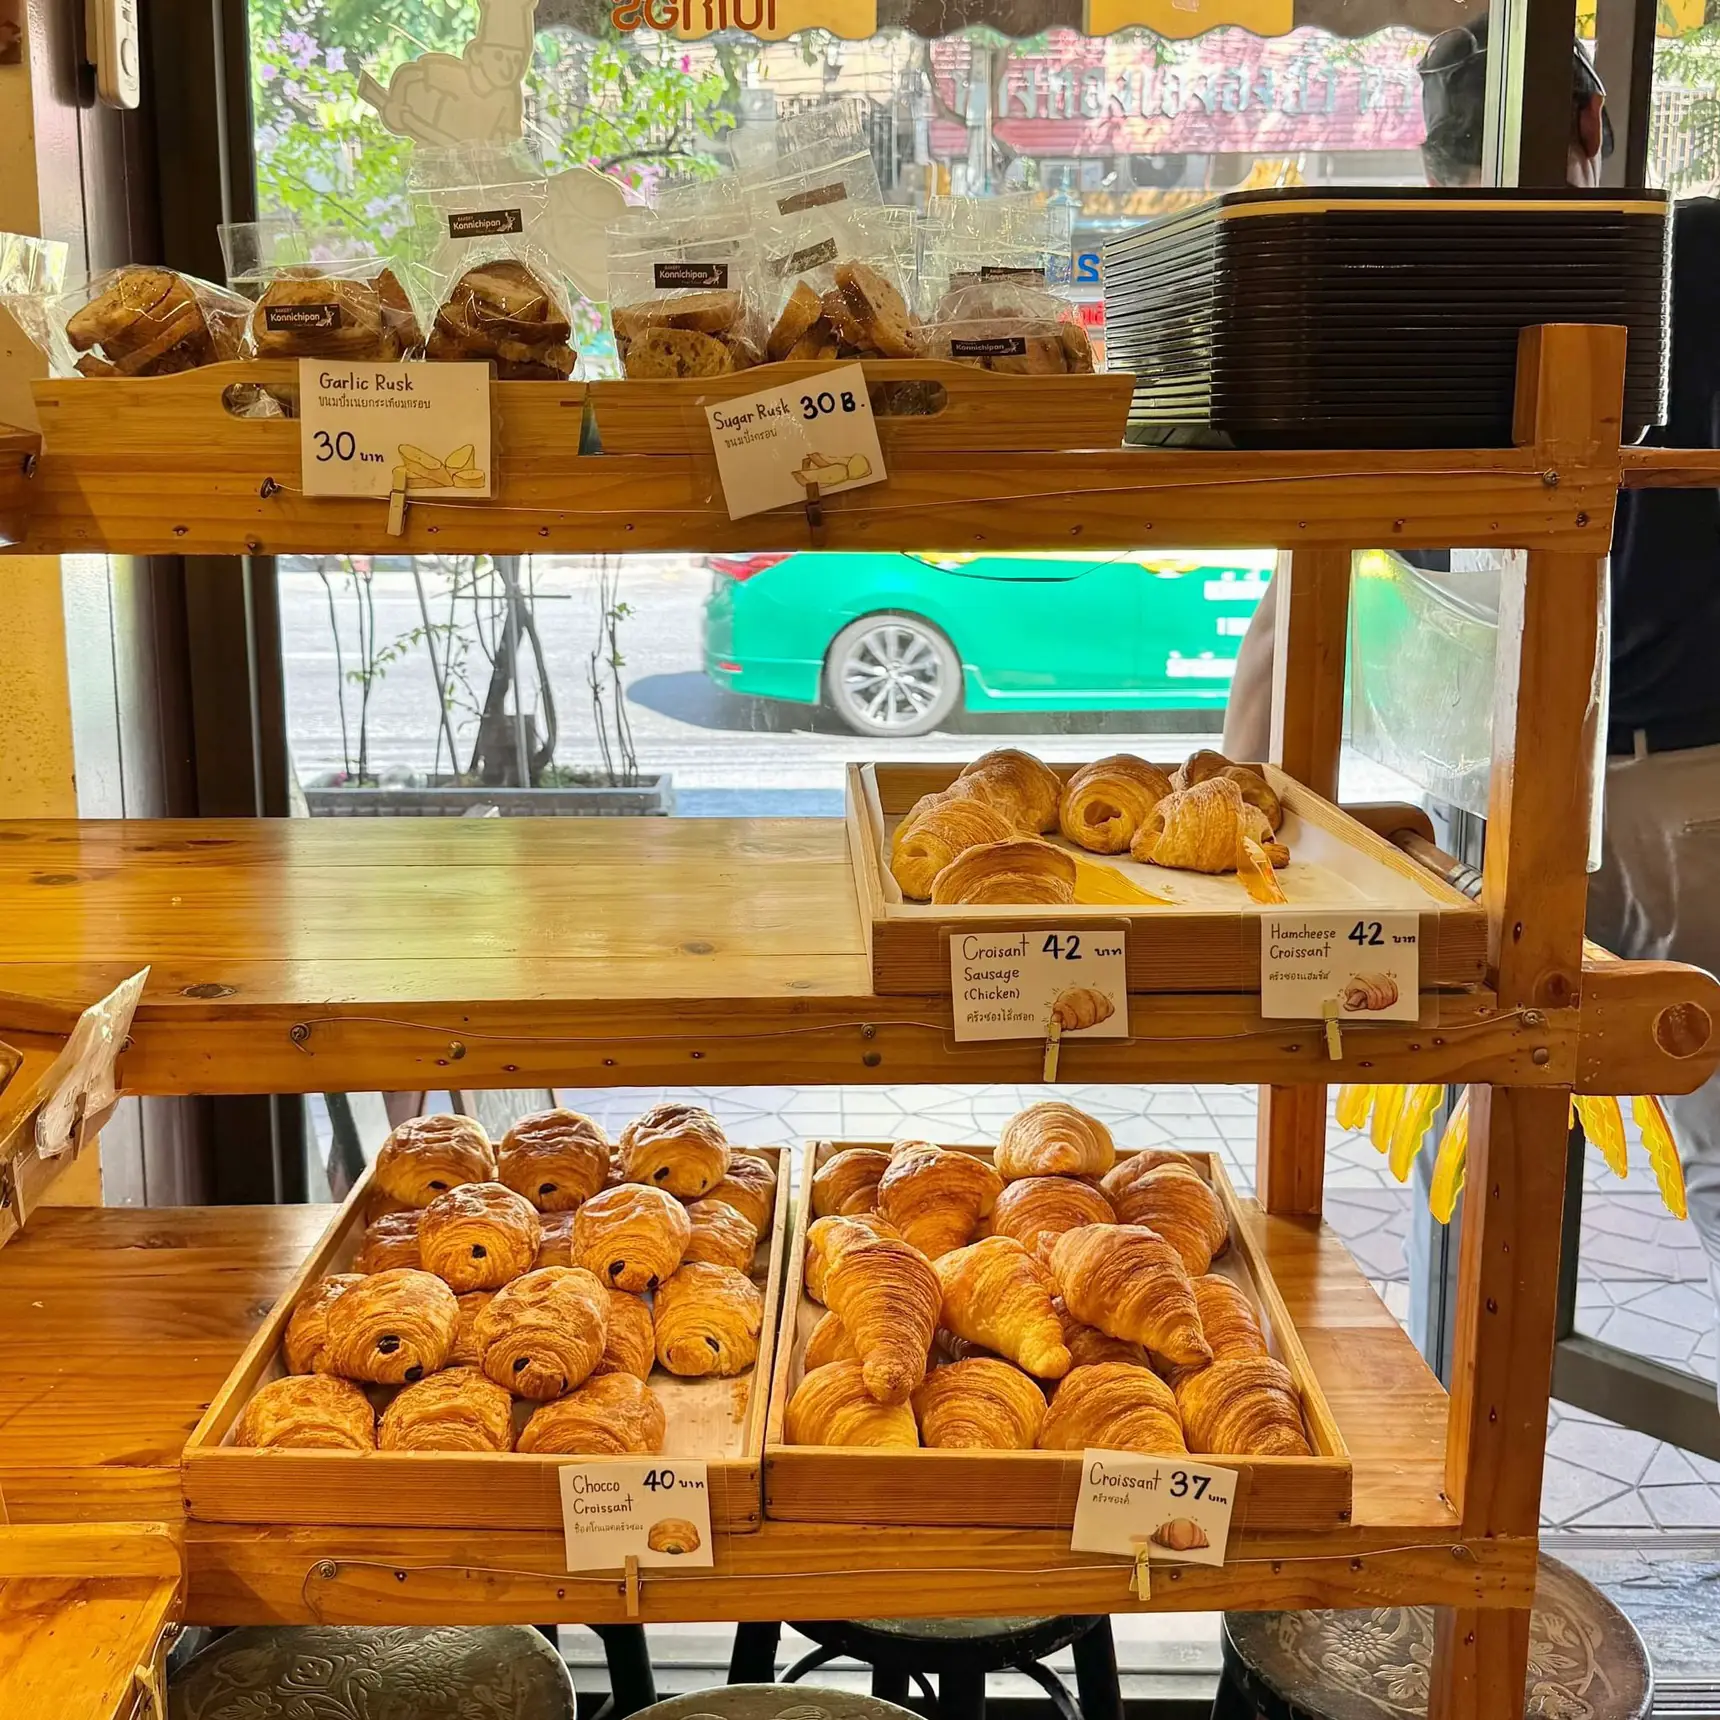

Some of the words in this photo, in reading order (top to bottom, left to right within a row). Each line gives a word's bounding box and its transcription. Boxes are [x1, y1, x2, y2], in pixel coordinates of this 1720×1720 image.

[453, 219, 501, 231] Konnichipan
[659, 269, 708, 280] Konnichipan
[270, 312, 320, 323] Konnichipan
[956, 343, 1005, 351] Konnichipan
[319, 372, 369, 391] Garlic
[376, 373, 414, 391] Rusk
[713, 411, 754, 431] Sugar
[756, 398, 791, 420] Rusk
[800, 392, 836, 420] 30
[313, 431, 356, 462] 30
[360, 451, 385, 463] บาท
[1271, 923, 1337, 939] Hamcheese
[1347, 921, 1385, 946] 42
[1392, 934, 1416, 944] บาท
[962, 933, 1030, 961] Croisant
[1042, 934, 1082, 960] 42
[1094, 948, 1122, 957] บาท
[1269, 942, 1332, 959] Croissant
[964, 967, 1020, 984] Sausage
[964, 985, 1020, 1001] (Chicken)
[572, 1474, 620, 1494] Chocco
[642, 1469, 675, 1492] 40
[678, 1479, 704, 1489] บาท
[1089, 1461, 1162, 1491] Croissant
[1169, 1470, 1212, 1500] 37
[1208, 1494, 1227, 1505] บาท
[573, 1493, 634, 1514] Croissant
